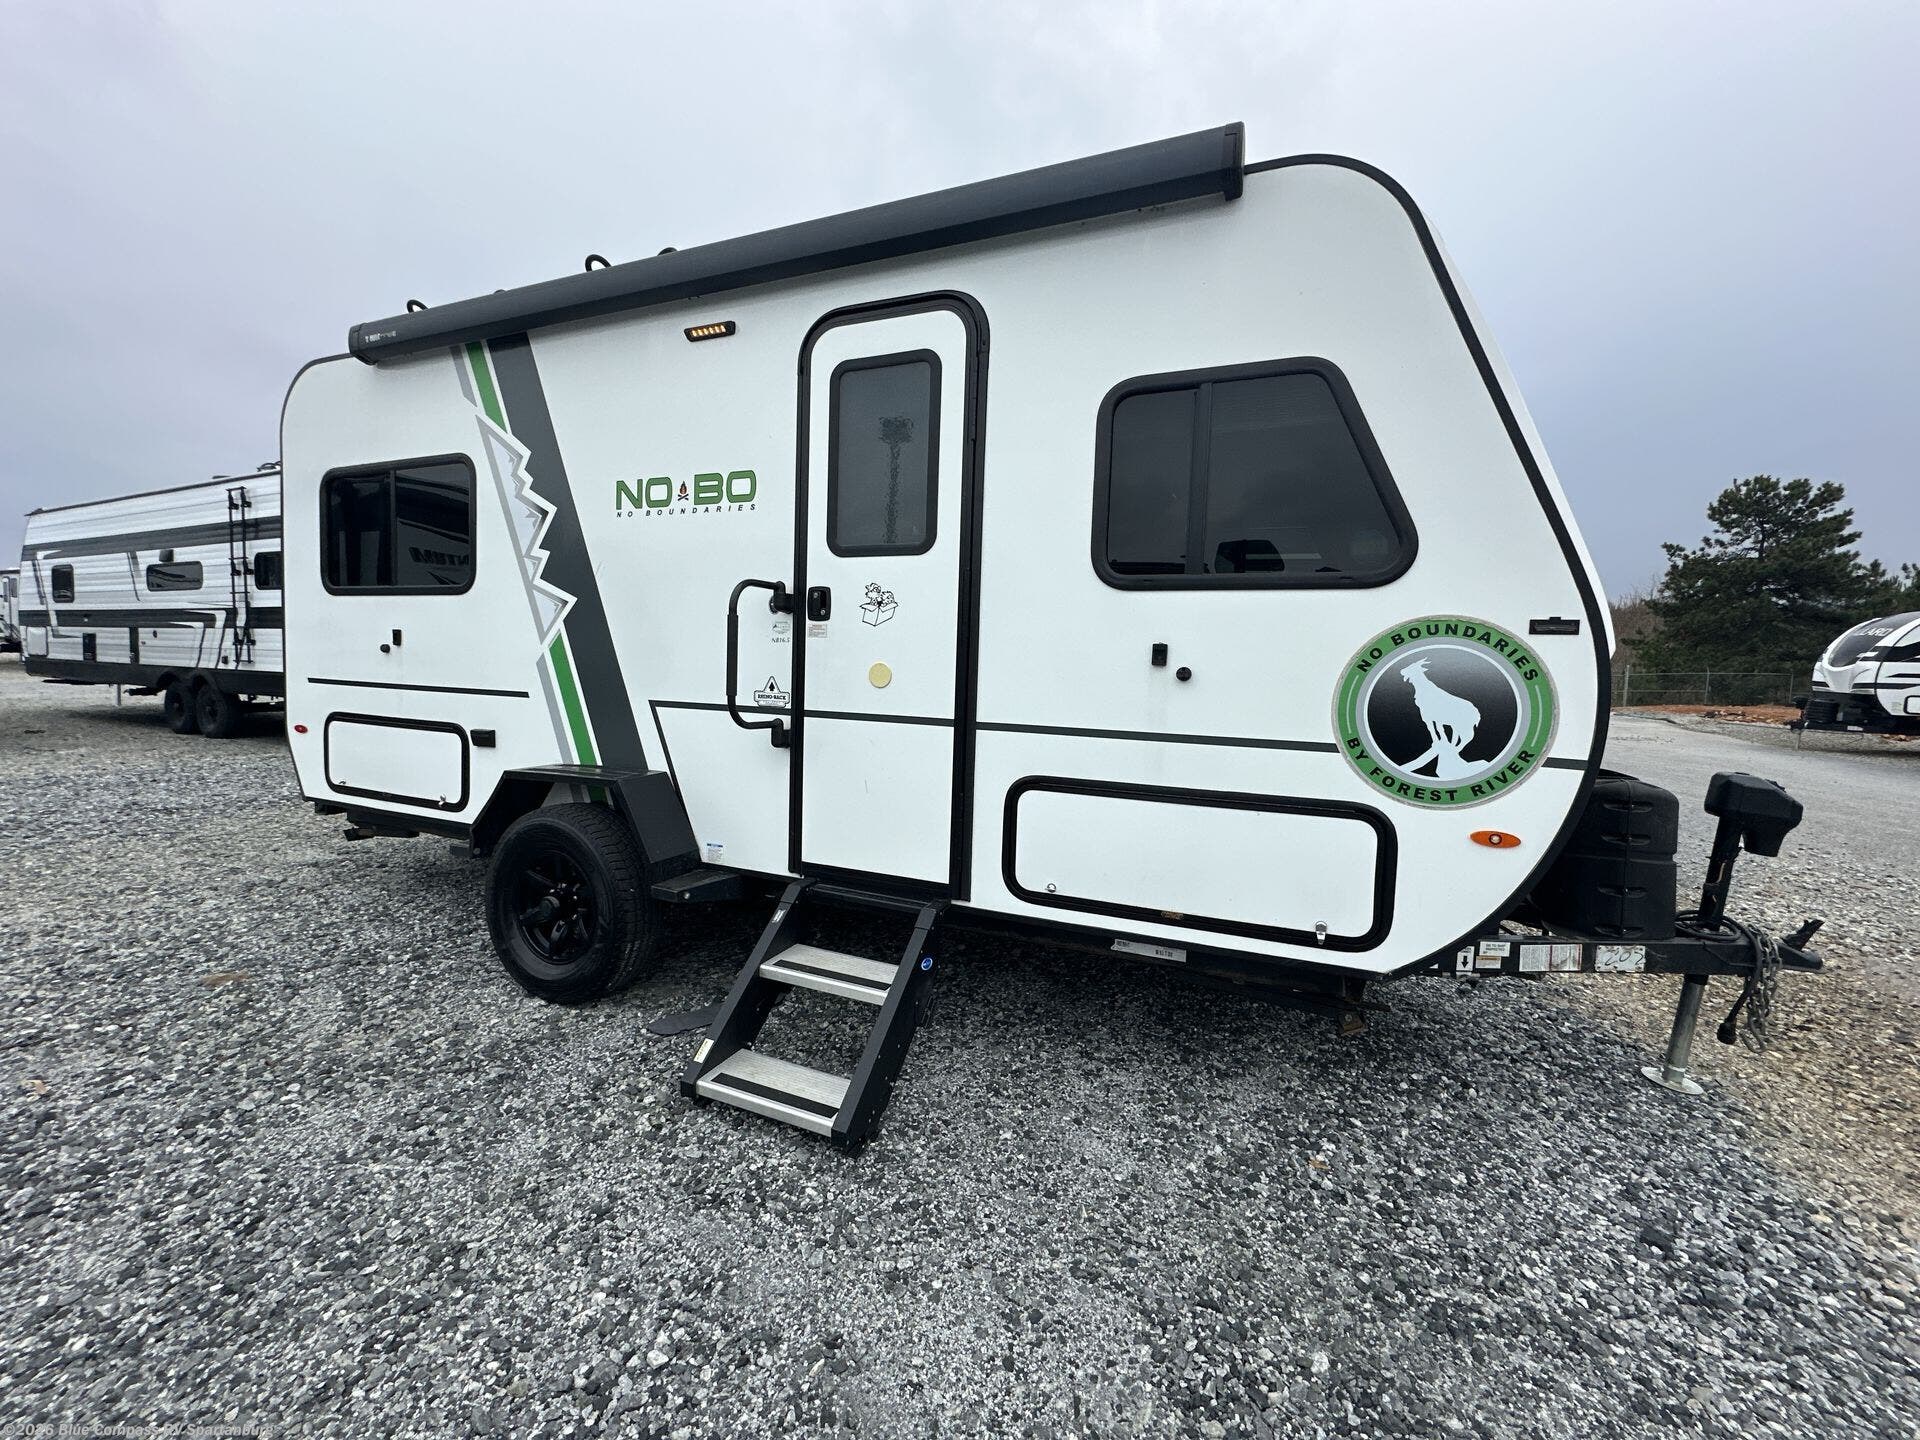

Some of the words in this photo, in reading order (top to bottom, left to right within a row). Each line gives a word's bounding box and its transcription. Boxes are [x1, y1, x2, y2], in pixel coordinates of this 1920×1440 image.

[616, 477, 673, 510] NO
[694, 470, 757, 505] BO
[646, 503, 756, 517] BOUNDARIES
[1356, 647, 1384, 673] NO
[1390, 623, 1539, 681] BOUNDARIES
[1347, 737, 1369, 763] BY
[1369, 766, 1458, 802] FOREST
[1470, 749, 1535, 797] RIVER
